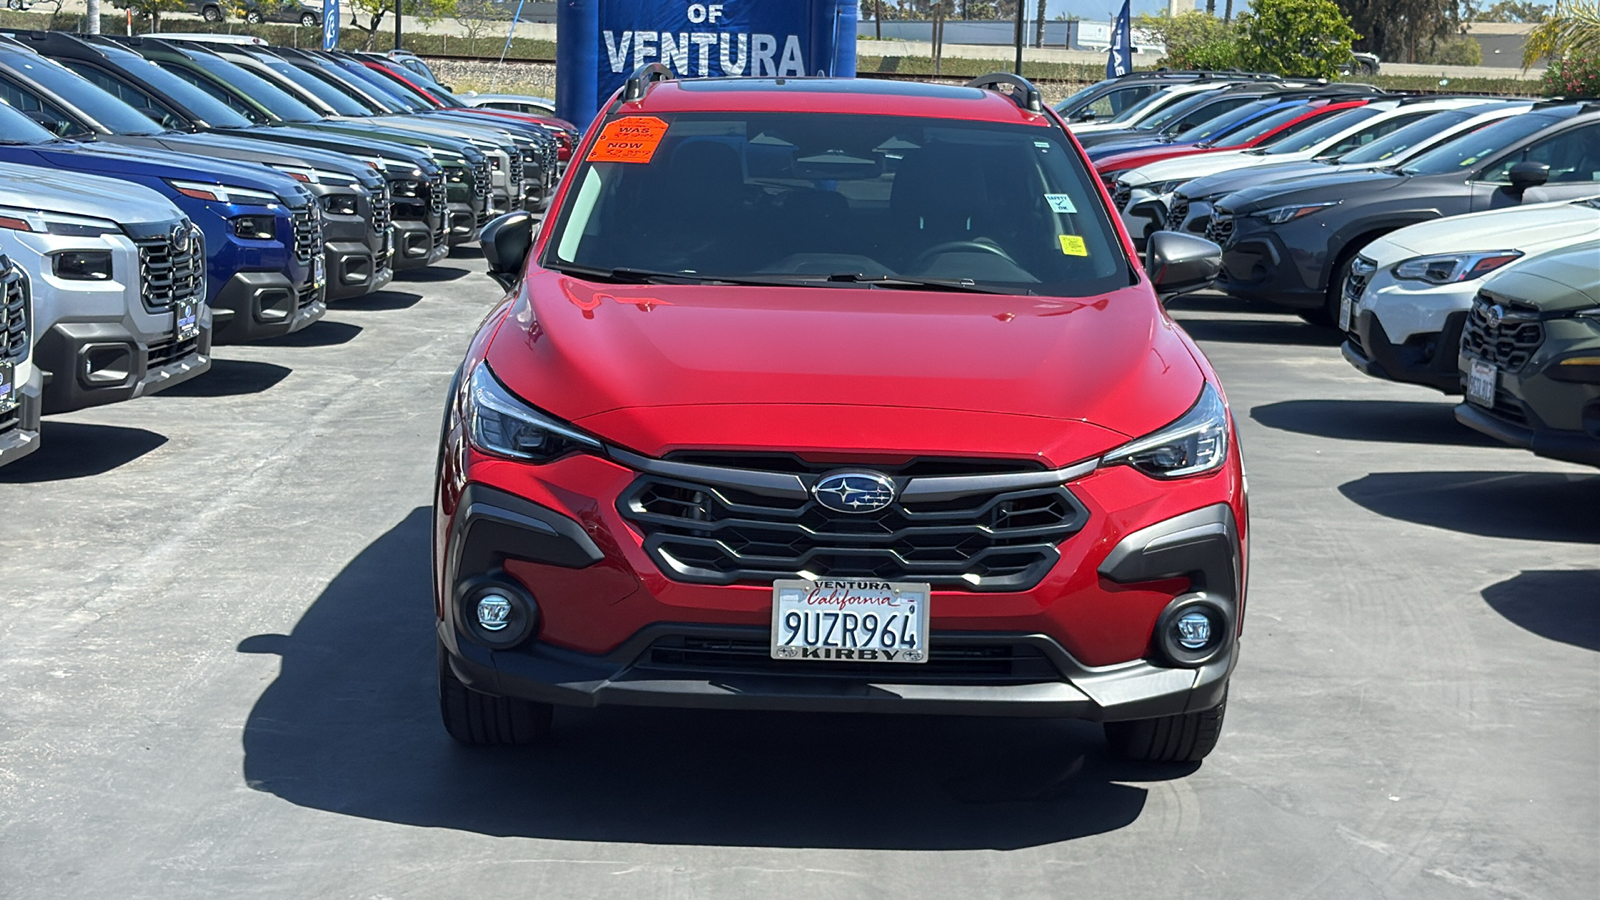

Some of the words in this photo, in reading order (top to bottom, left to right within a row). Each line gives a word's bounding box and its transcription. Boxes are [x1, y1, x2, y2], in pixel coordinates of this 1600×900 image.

[687, 4, 724, 23] OF
[602, 30, 807, 78] VENTURA
[814, 581, 891, 590] VENTURA
[807, 588, 901, 611] California
[784, 611, 917, 648] 9UZR964
[802, 648, 900, 660] KIRBY
